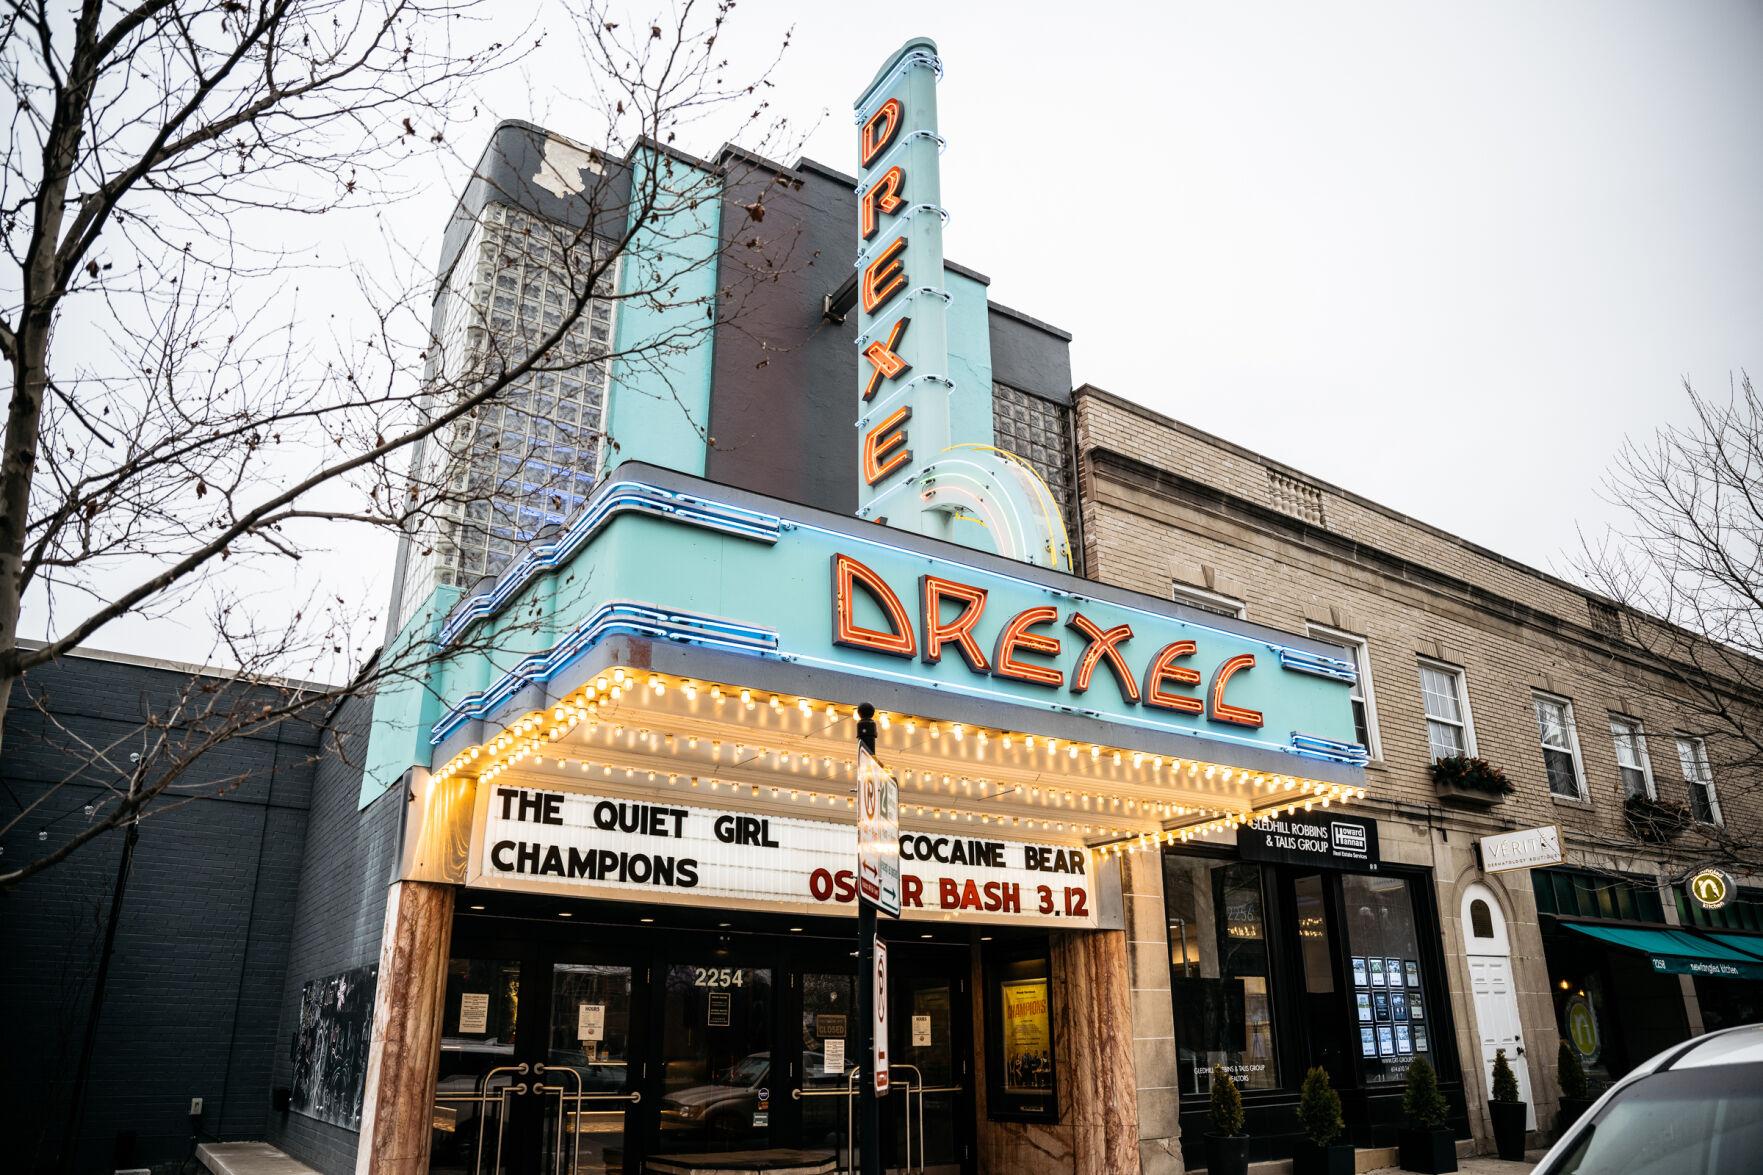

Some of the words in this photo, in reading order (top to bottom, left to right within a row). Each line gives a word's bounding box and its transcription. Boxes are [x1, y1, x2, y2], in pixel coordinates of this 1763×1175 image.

[862, 98, 913, 525] DREXE
[830, 552, 1264, 729] DREXEL
[497, 788, 564, 826] THE
[593, 801, 688, 838] QUIET
[714, 815, 779, 848] GIRL
[1250, 818, 1290, 834] GLEDHILL
[1292, 823, 1328, 839] ROBBINS
[899, 834, 1006, 868] COCAINE
[1024, 845, 1085, 875] BEAR
[1266, 835, 1273, 847] &
[1298, 838, 1329, 853] GROUP
[1353, 852, 1368, 860] Services
[491, 840, 699, 888] CHAMPIONS
[809, 868, 923, 908] OSR
[939, 877, 1021, 913] BASH
[1037, 885, 1089, 917] 3.12
[1227, 905, 1254, 921] 2256
[694, 968, 743, 988] 2254
[819, 1025, 845, 1034] CLOSED
